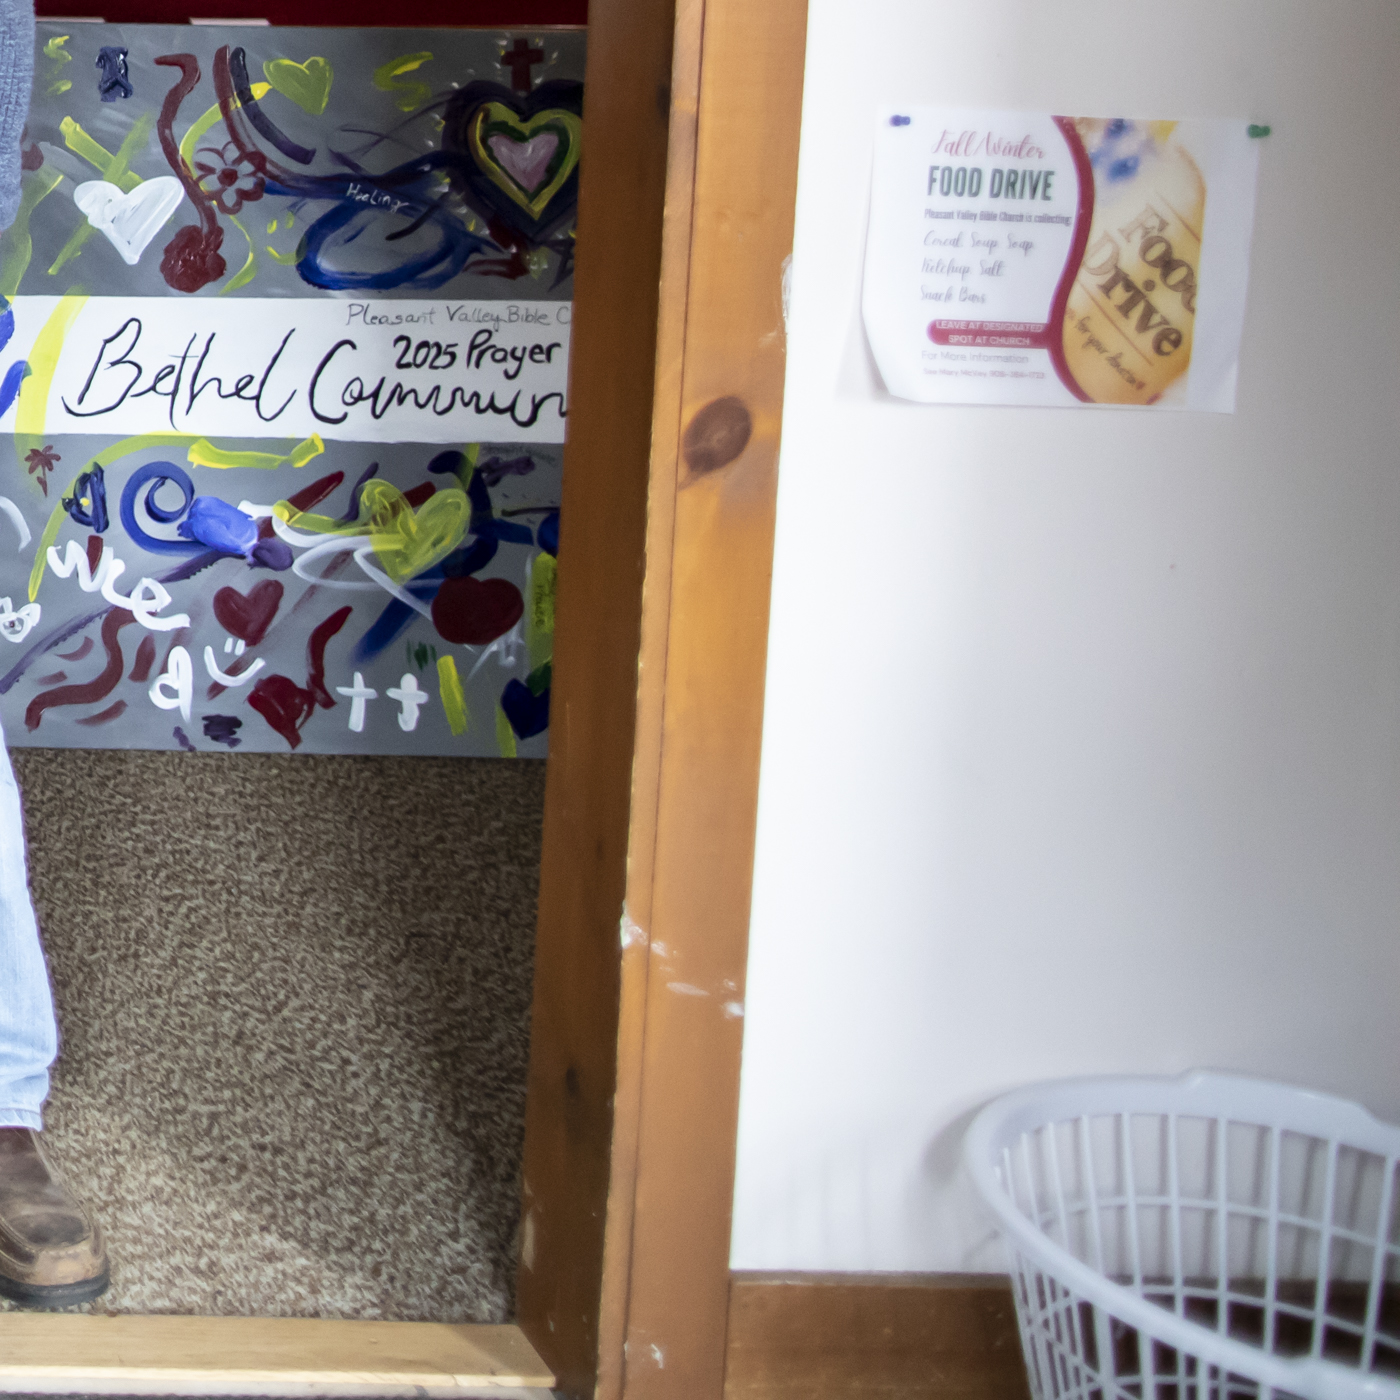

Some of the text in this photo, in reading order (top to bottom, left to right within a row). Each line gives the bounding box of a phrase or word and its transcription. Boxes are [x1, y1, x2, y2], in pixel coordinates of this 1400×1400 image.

[927, 165, 1055, 201] FOOD DRIVE
[924, 208, 954, 220] Pleasant
[956, 210, 977, 222] Valley
[979, 211, 997, 221] Bible
[999, 211, 1023, 222] Church
[1082, 231, 1183, 357] Drive
[346, 303, 436, 326] Pleasant
[446, 305, 503, 332] Valley
[506, 306, 550, 325] Bible
[936, 321, 1043, 332] LEAVE AT DESIGNATED
[393, 329, 562, 380] 2025 Prayer
[949, 335, 973, 343] SPOT
[989, 336, 1030, 345] CHURCH
[922, 351, 1029, 363] For More Information
[61, 317, 297, 432] Bethel
